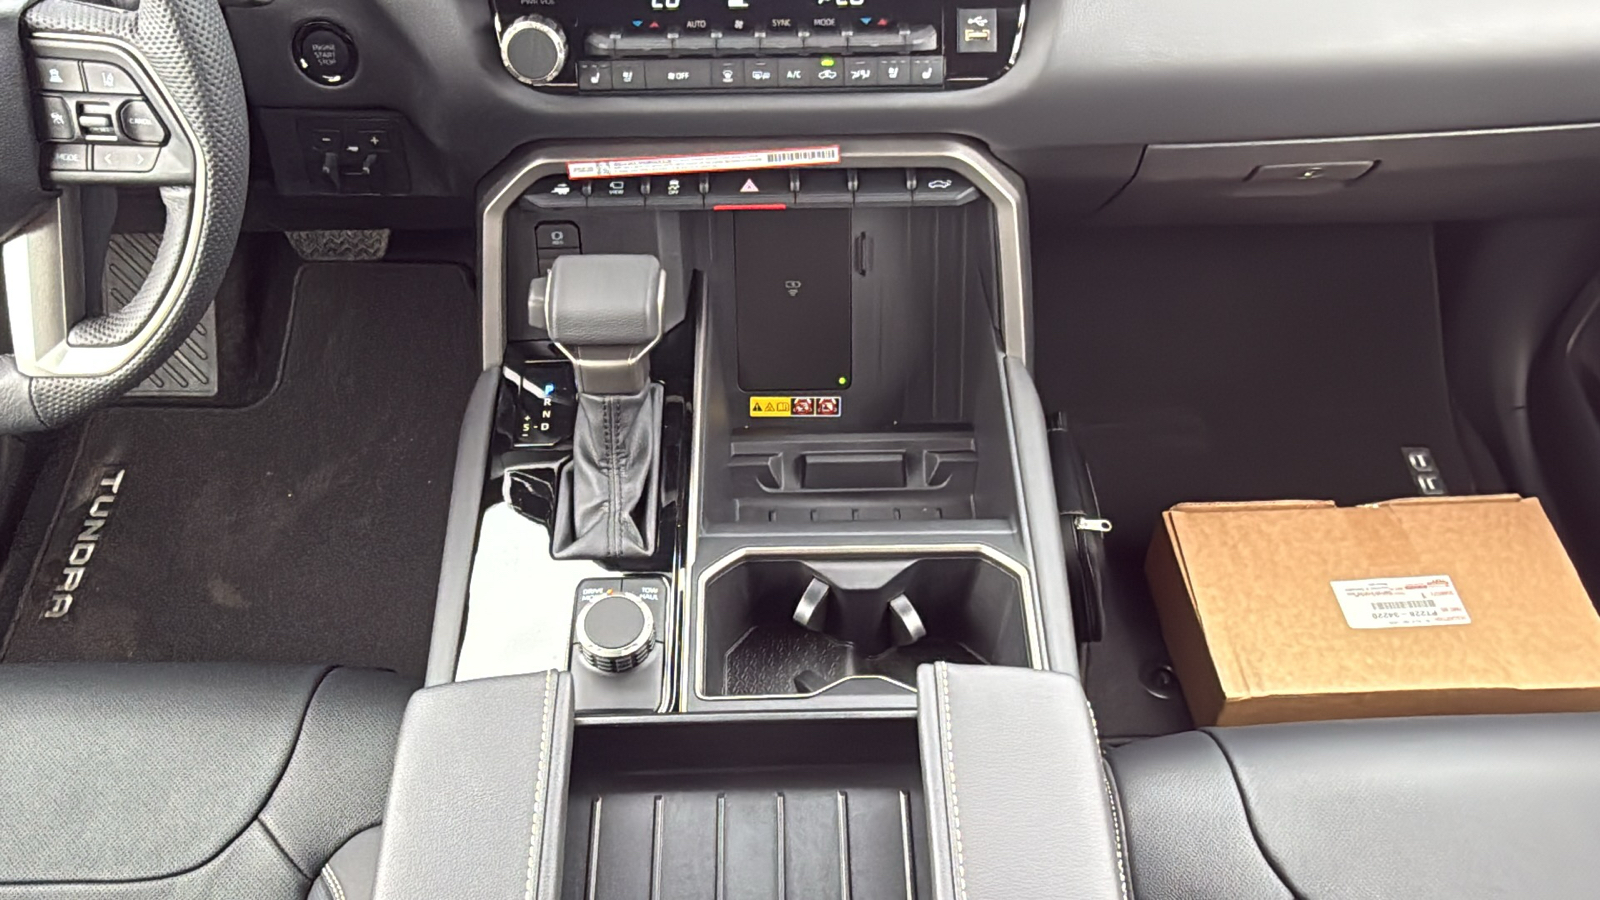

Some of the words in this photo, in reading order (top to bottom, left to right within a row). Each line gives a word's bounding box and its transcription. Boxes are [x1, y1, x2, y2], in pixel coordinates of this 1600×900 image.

[687, 20, 707, 28] AUTO
[772, 19, 791, 27] SYNC
[813, 18, 836, 26] MODE
[786, 71, 801, 79] A/C
[55, 153, 79, 162] MODE
[545, 383, 555, 396] P
[543, 398, 552, 406] R
[542, 410, 552, 418] N
[522, 423, 530, 432] S
[540, 422, 550, 431] D
[44, 469, 126, 618] TUNDRA
[582, 587, 604, 595] DRIVE
[641, 586, 659, 594] TOW
